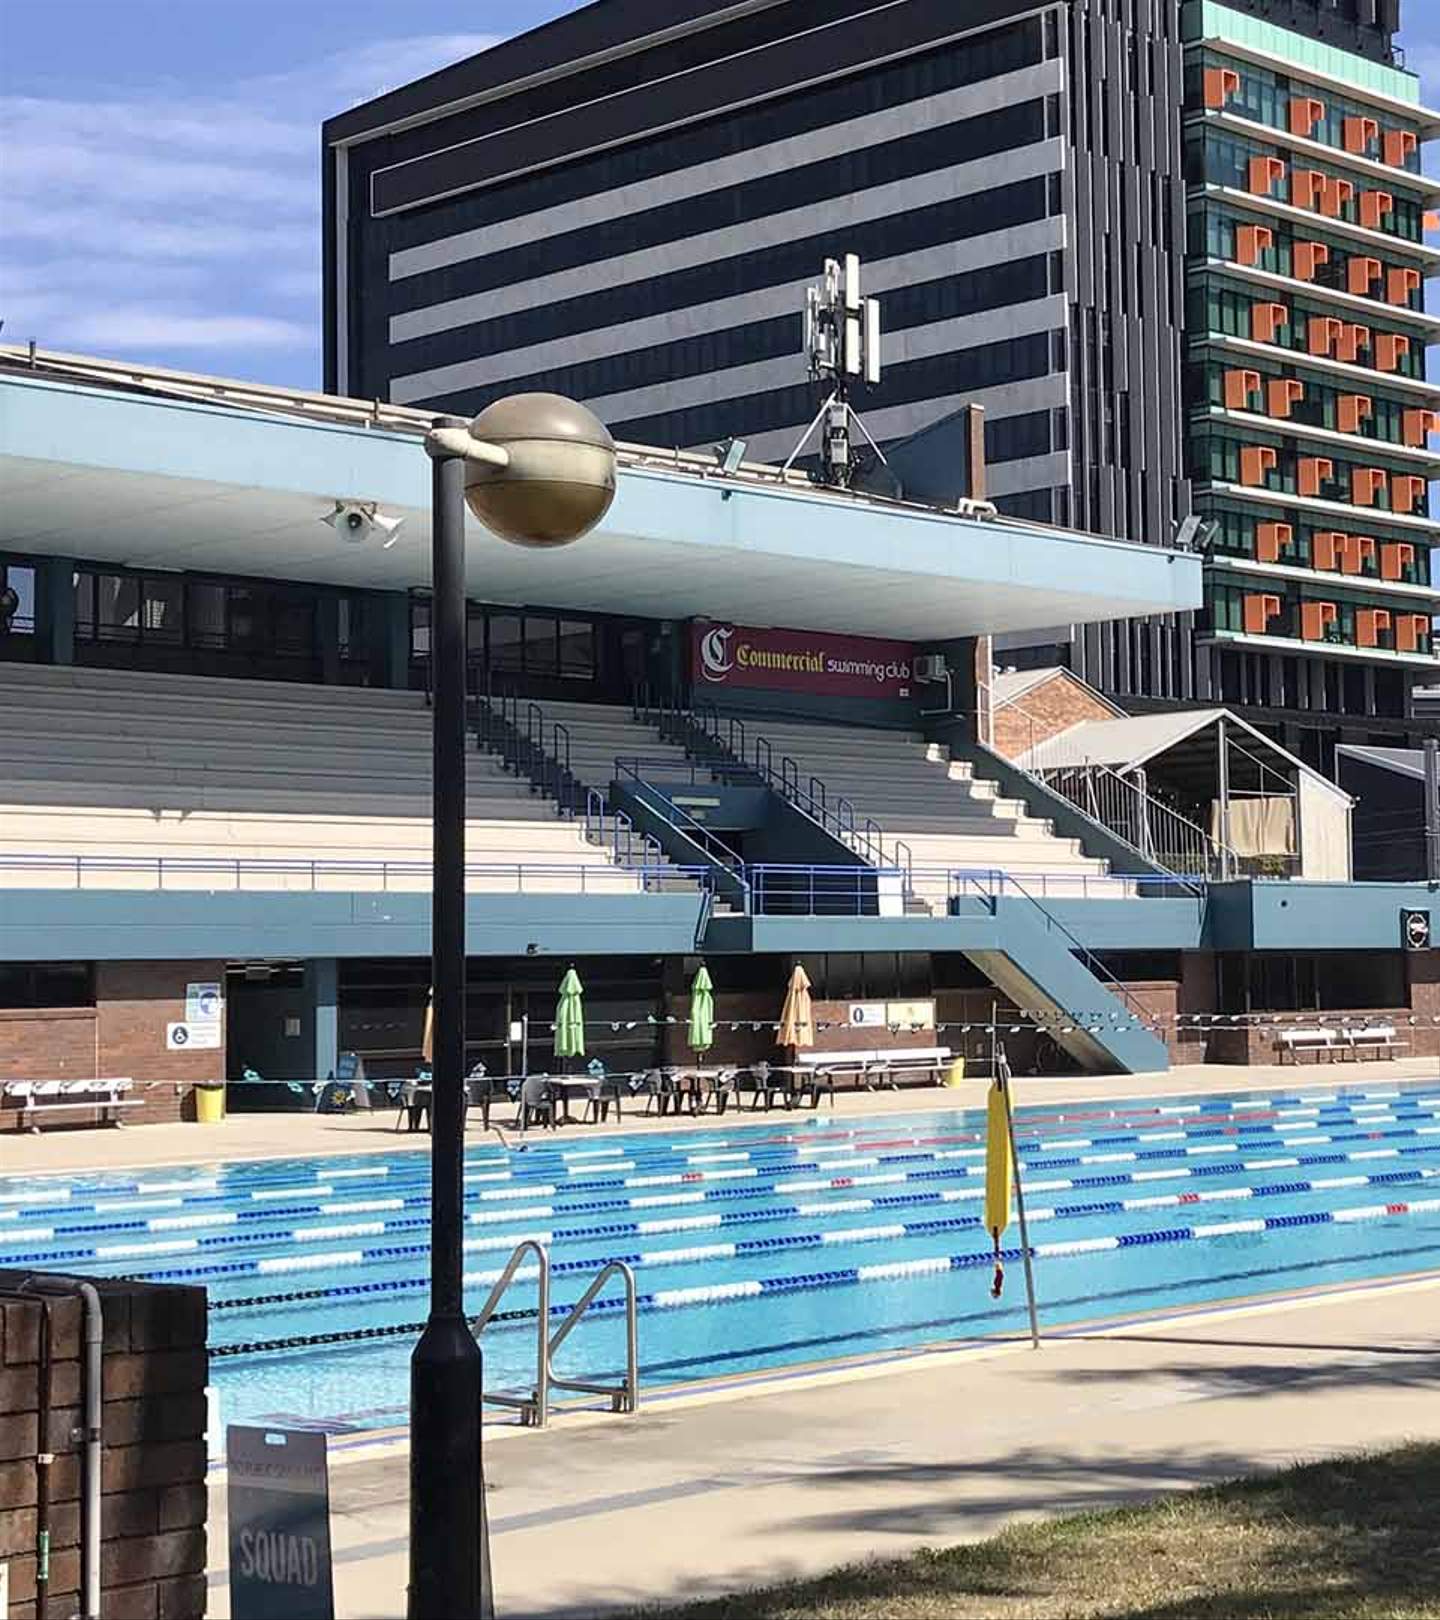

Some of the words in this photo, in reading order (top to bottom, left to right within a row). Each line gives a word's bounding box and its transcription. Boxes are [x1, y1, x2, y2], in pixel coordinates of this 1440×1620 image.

[736, 644, 825, 673] Commercial
[827, 659, 885, 682] swimming
[886, 661, 911, 678] club
[240, 1528, 319, 1584] SQUAD
